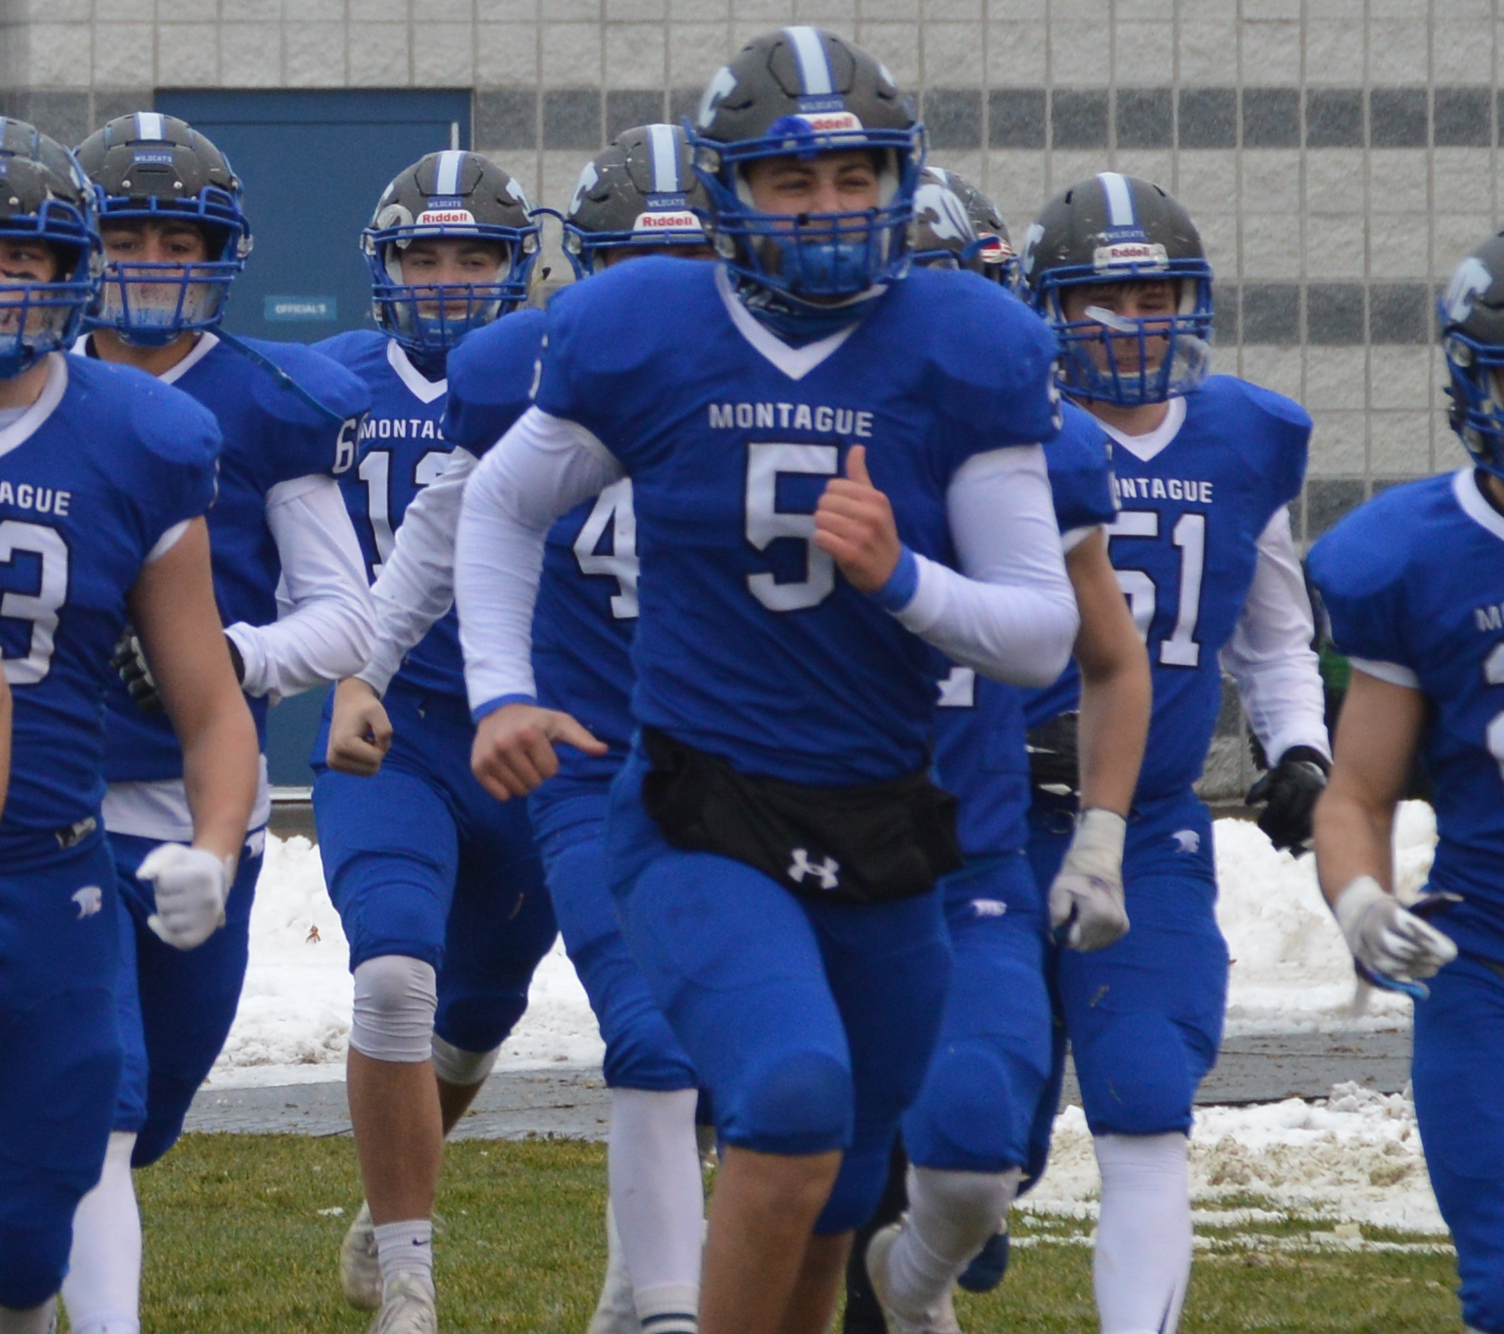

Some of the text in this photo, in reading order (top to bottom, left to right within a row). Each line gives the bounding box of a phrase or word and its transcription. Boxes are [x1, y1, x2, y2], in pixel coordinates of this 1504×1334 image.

[422, 213, 468, 224] Riddell
[642, 216, 693, 227] Riddell
[708, 403, 874, 437] MONTAGUE
[745, 442, 839, 612] 5
